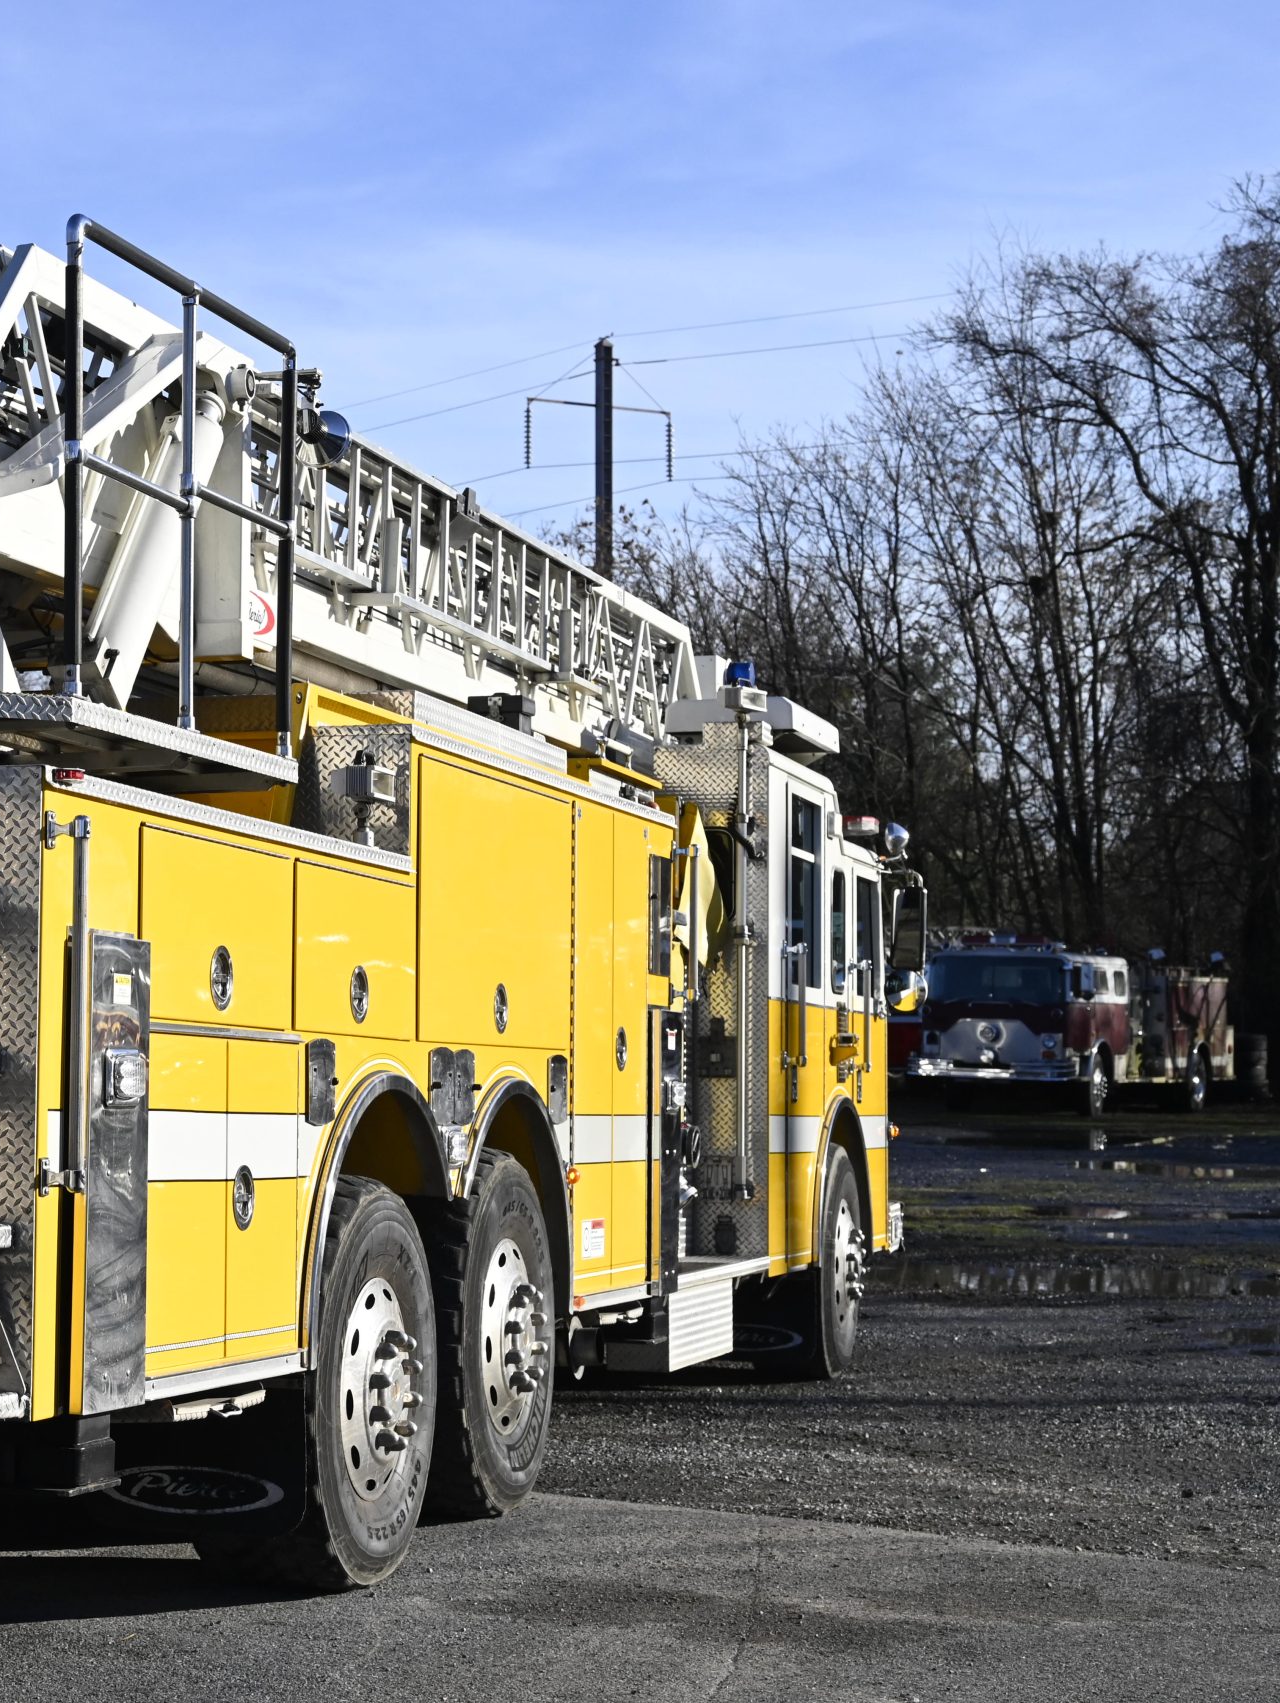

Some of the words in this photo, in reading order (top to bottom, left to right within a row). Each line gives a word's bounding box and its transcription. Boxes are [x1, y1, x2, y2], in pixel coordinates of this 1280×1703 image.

[508, 1382, 546, 1468] MICHELIN
[389, 1522, 397, 1536] R
[396, 1459, 422, 1529] 445/65
